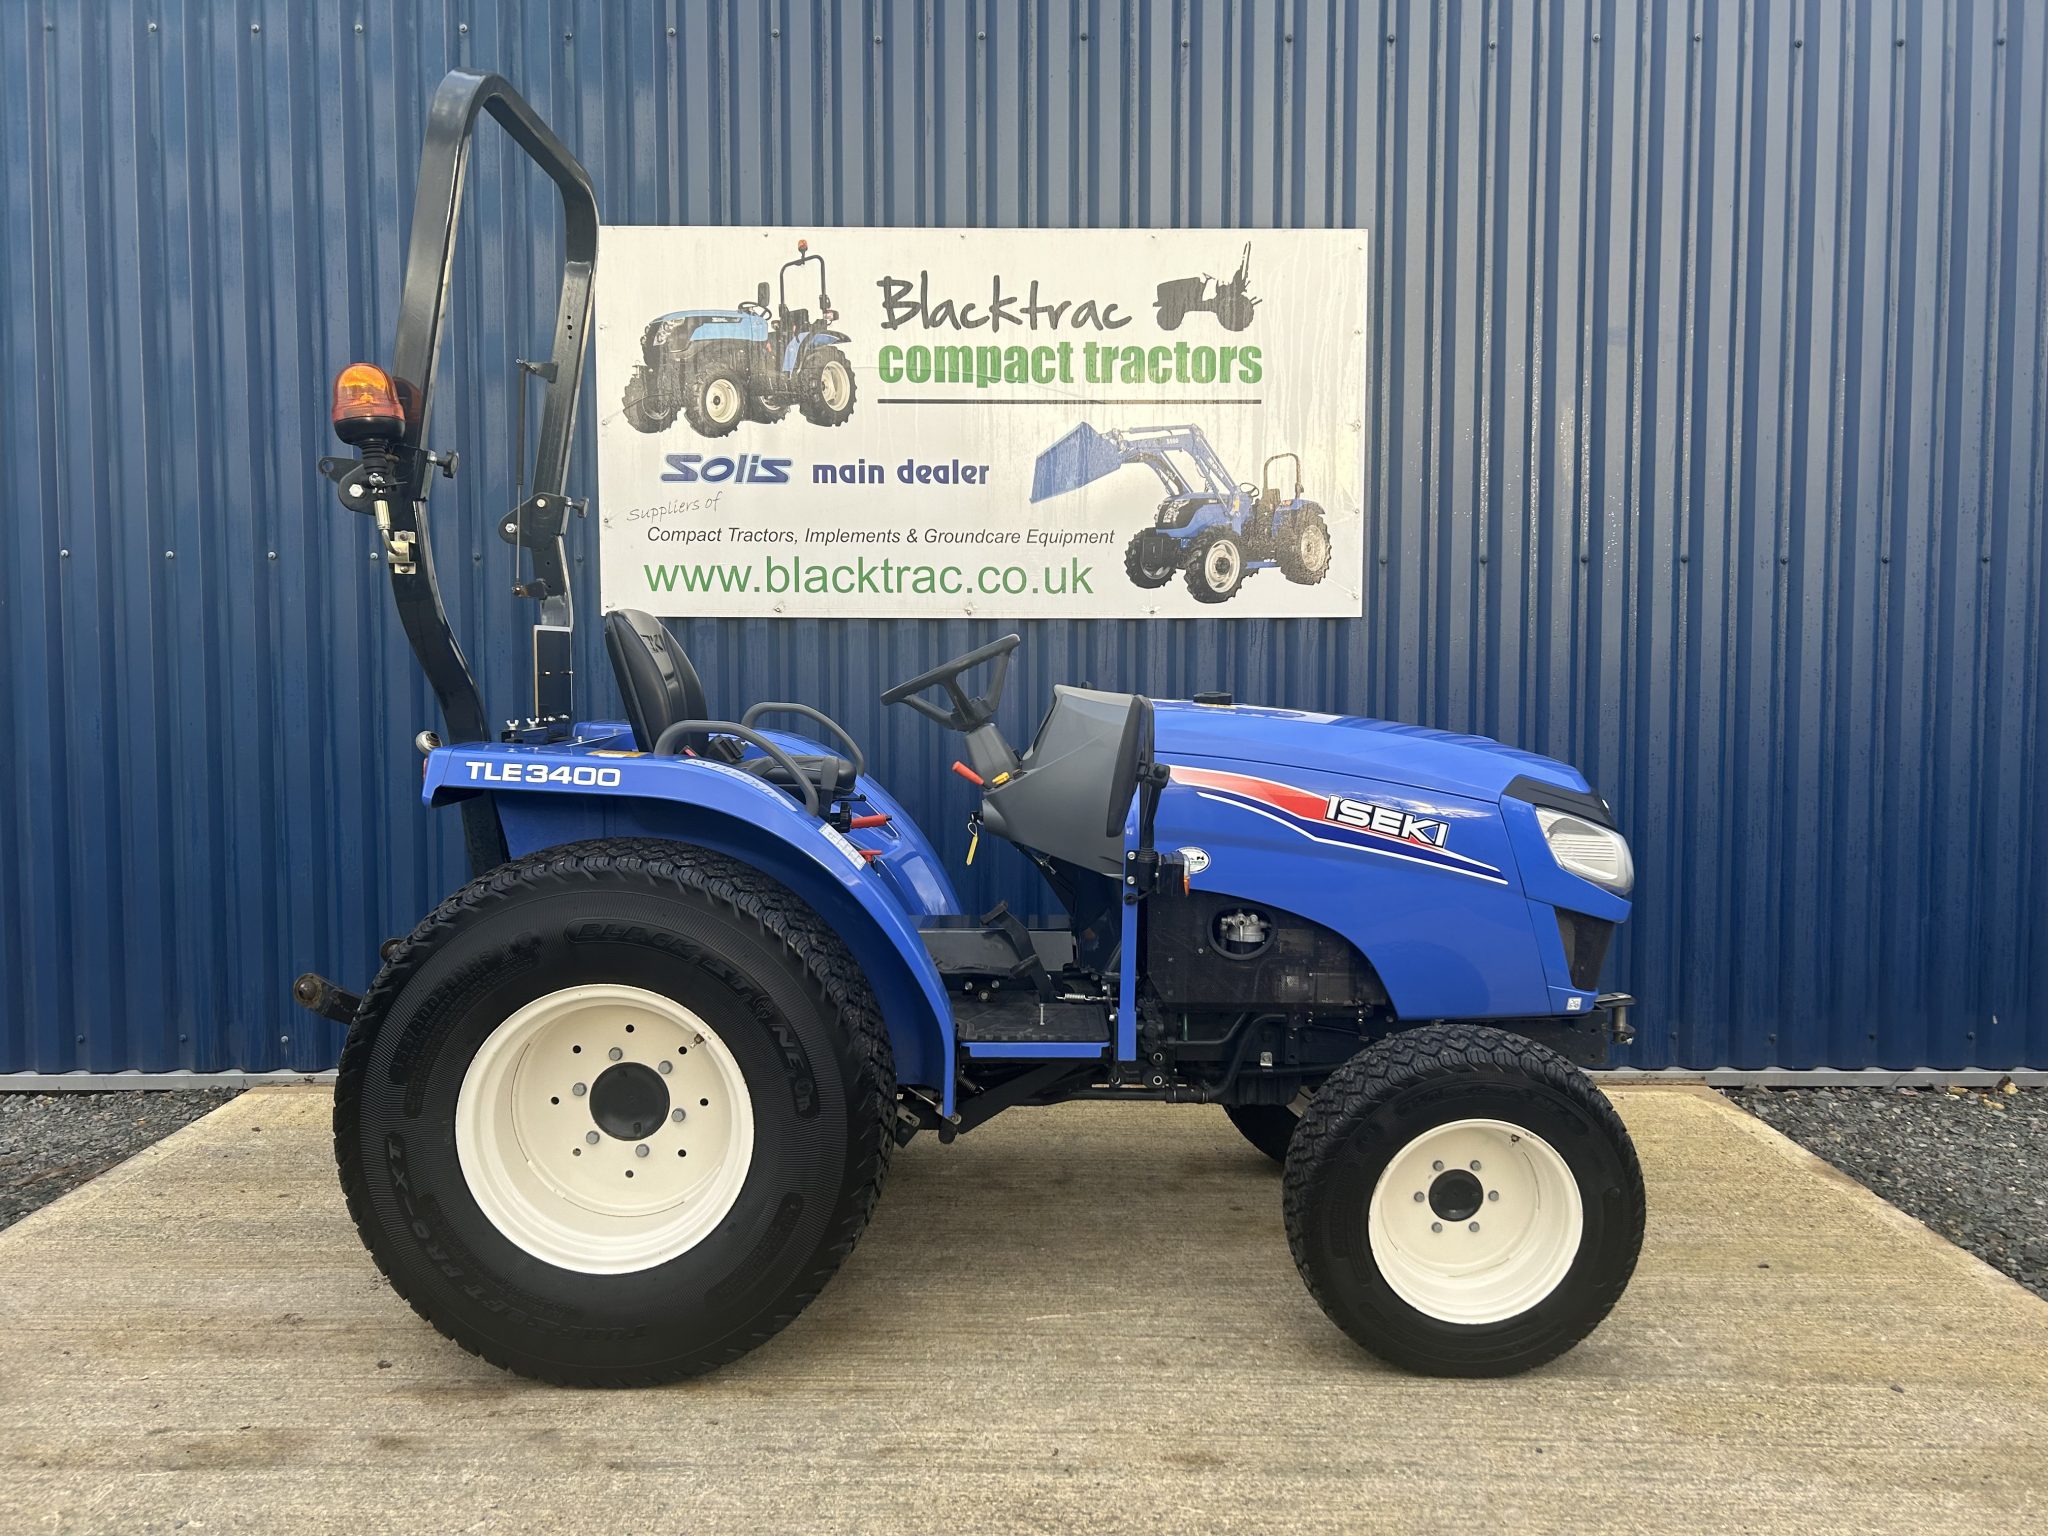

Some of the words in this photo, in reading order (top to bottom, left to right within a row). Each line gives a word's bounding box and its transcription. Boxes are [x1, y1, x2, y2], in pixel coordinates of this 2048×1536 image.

[876, 270, 1133, 333] Blacktrac
[879, 342, 1073, 388] compact
[1083, 342, 1263, 383] tractors
[813, 458, 885, 484] main
[897, 458, 989, 484] dealer
[626, 499, 700, 523] Suppliers
[704, 490, 723, 512] of
[647, 526, 722, 545] Compact
[728, 527, 798, 545] Tractors,
[805, 527, 901, 546] Implements
[906, 528, 918, 543] &
[924, 528, 1021, 544] Groundcare
[1026, 529, 1114, 547] Equipment
[644, 556, 1093, 594] www.blacktrac.co.uk
[465, 761, 621, 787] TLE3400
[1325, 794, 1450, 849] ISEKI
